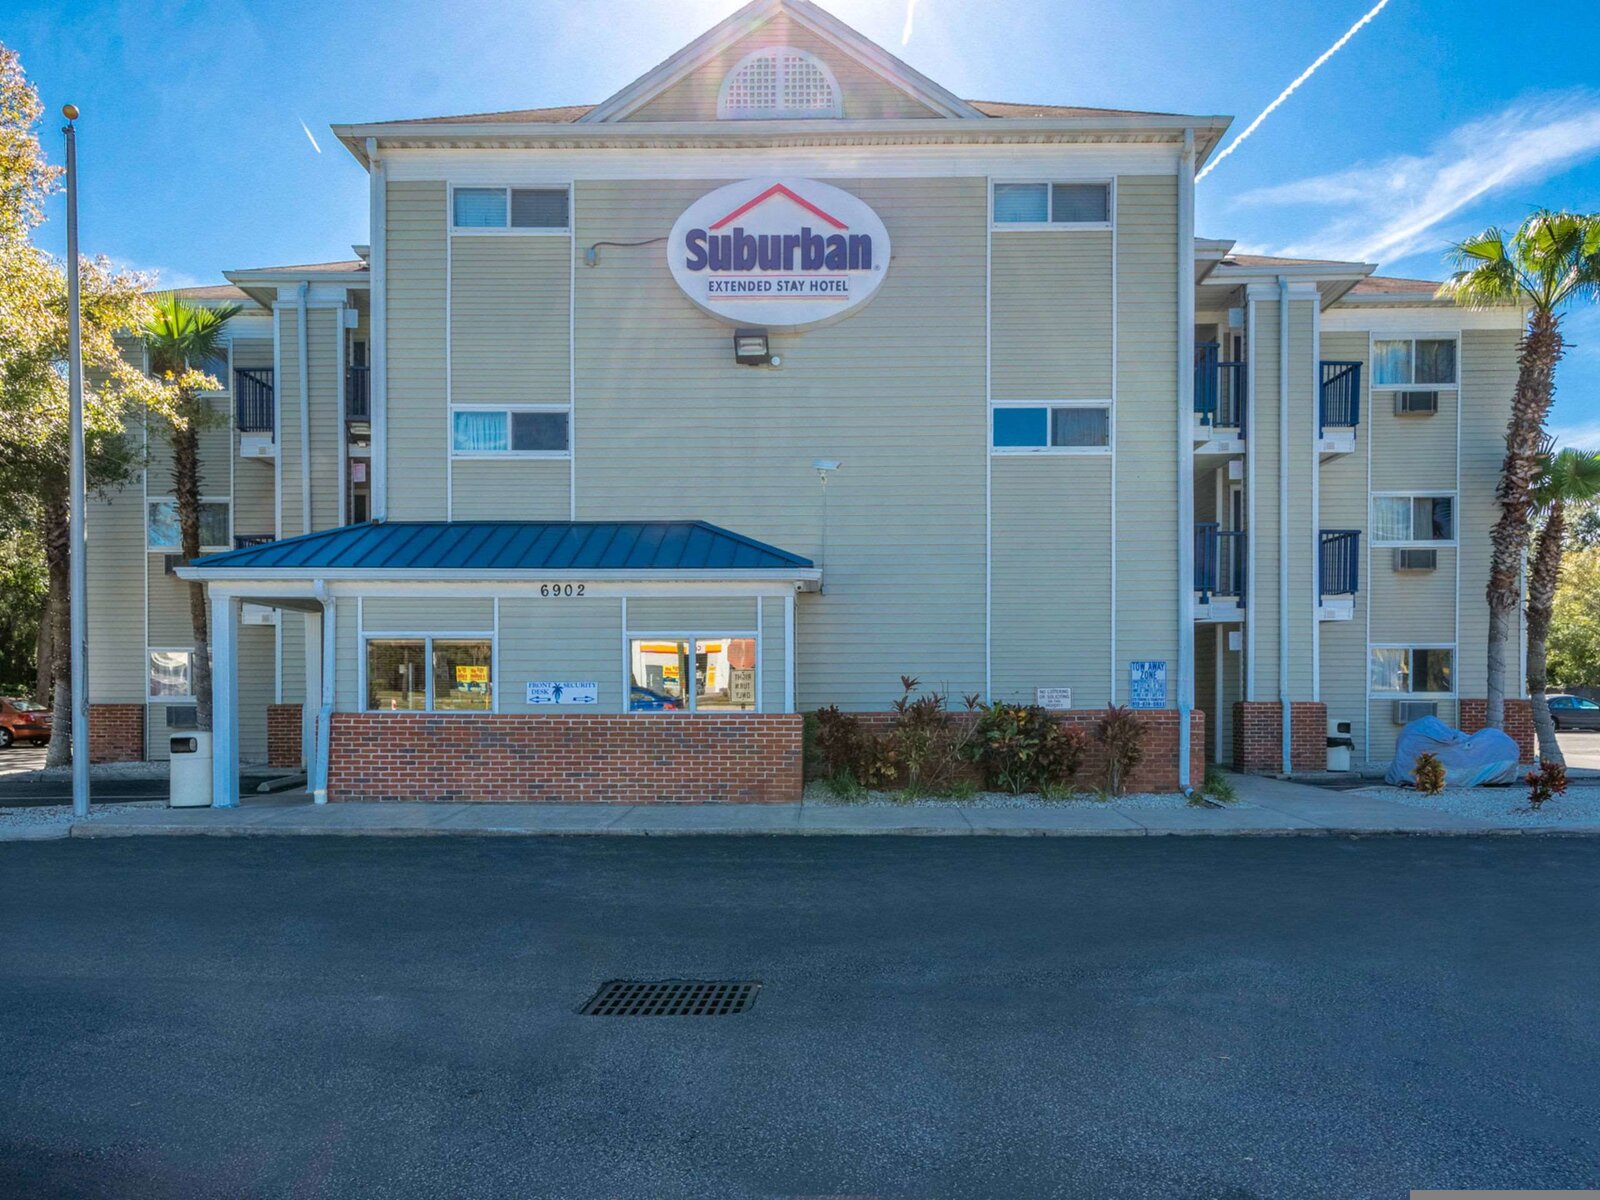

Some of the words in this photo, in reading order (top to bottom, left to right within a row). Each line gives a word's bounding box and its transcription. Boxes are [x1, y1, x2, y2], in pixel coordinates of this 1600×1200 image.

[685, 226, 872, 271] Suburban
[708, 280, 772, 292] EXTENDED
[776, 280, 805, 292] STAY
[810, 280, 848, 292] HOTEL
[540, 584, 585, 597] 6902
[1132, 662, 1145, 671] TOW
[1148, 662, 1165, 671] AWAY
[1140, 670, 1157, 680] ZONE
